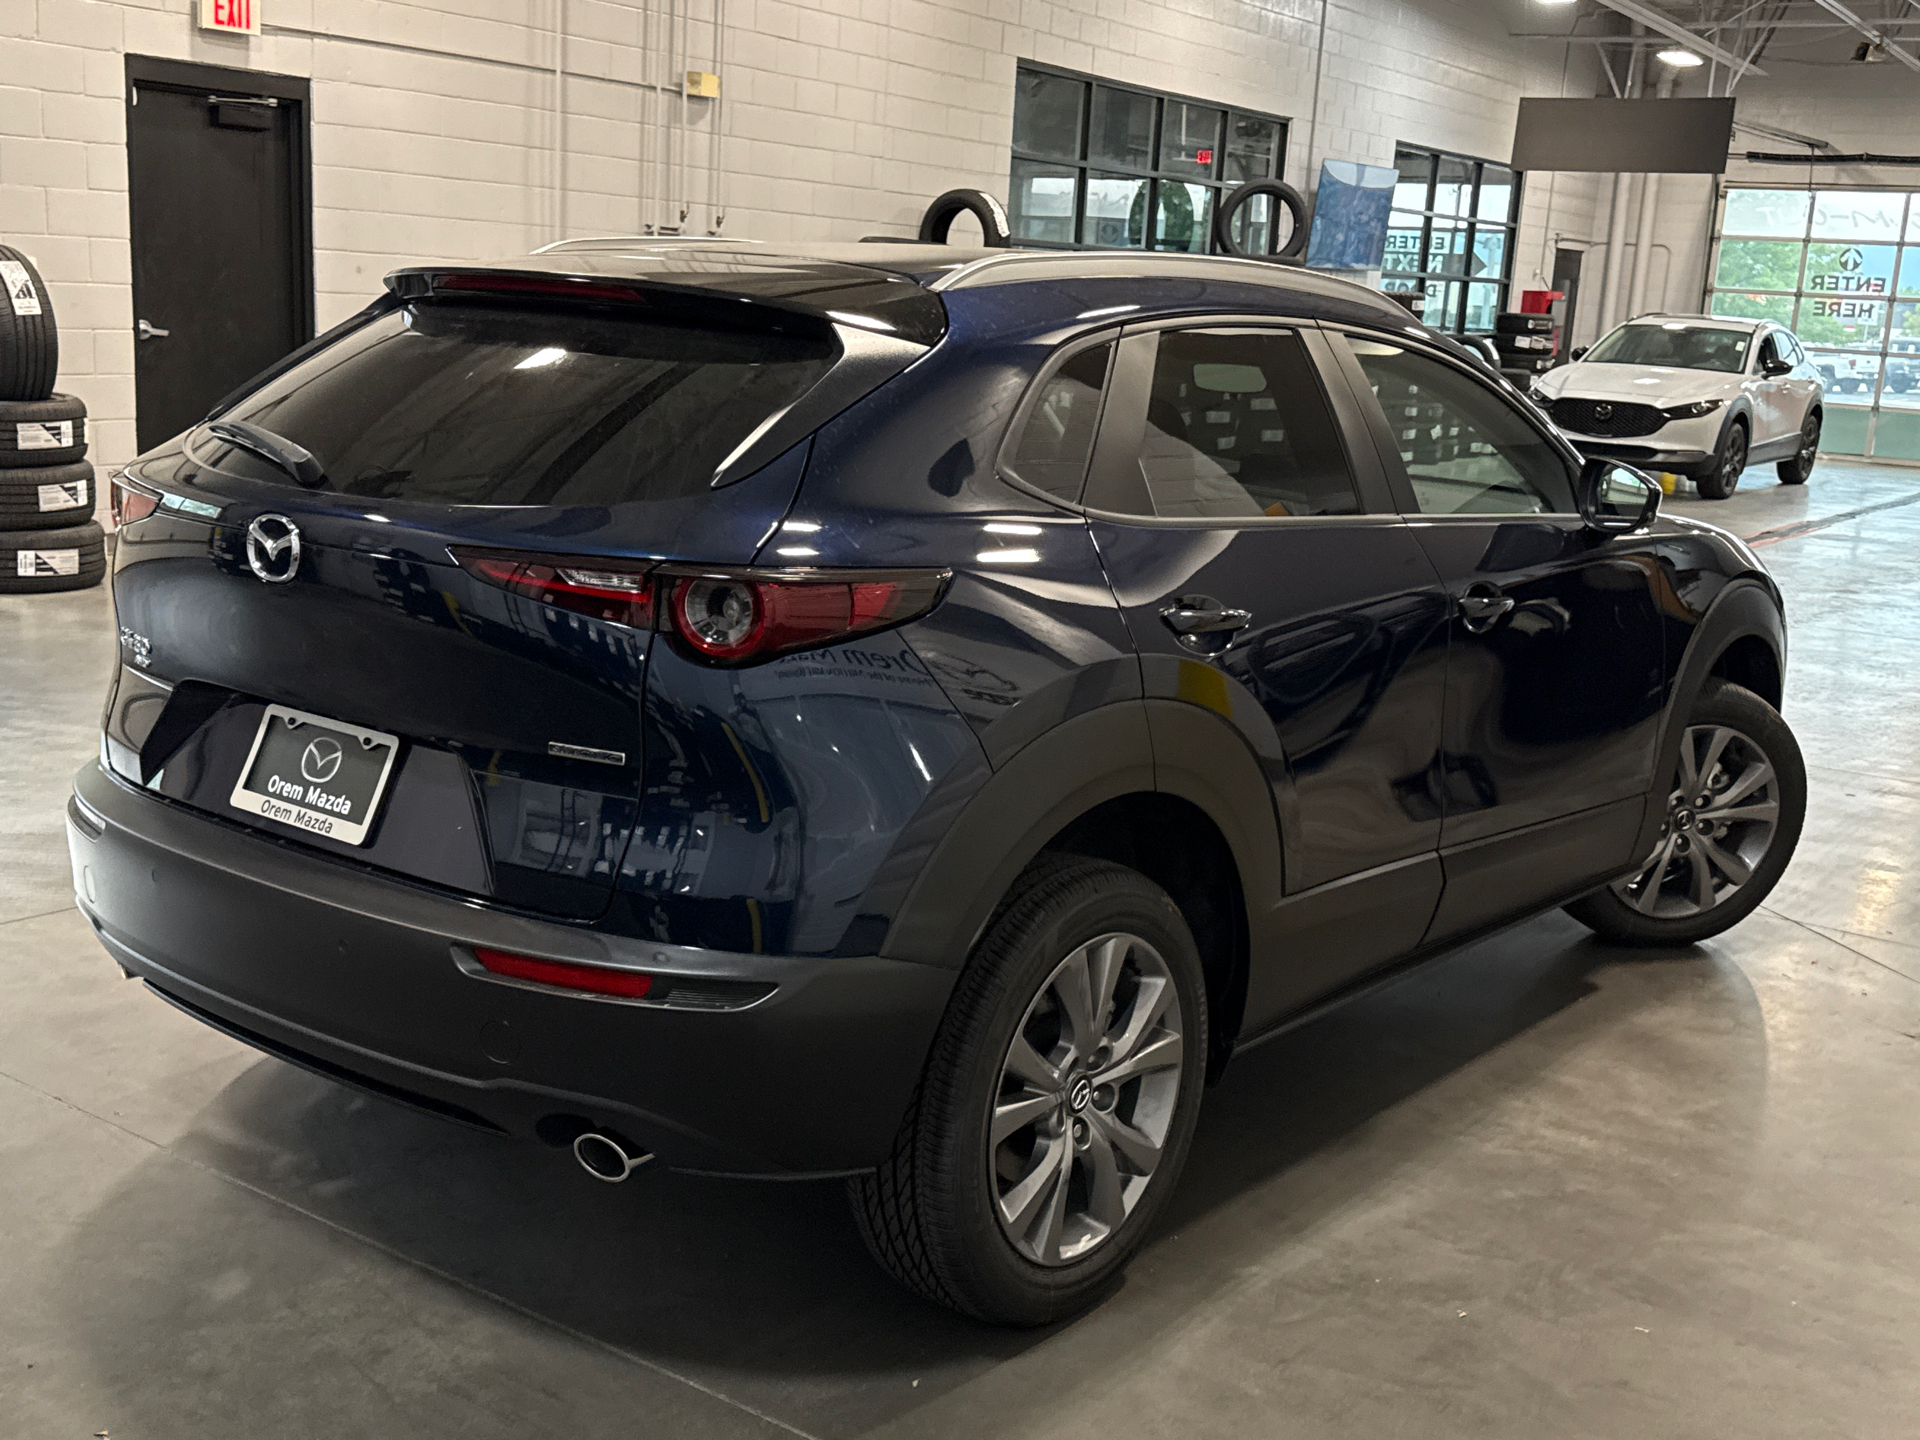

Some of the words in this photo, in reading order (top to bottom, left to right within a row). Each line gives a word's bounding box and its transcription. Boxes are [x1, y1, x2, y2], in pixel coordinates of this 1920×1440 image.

[267, 774, 304, 800] Orem
[305, 786, 351, 815] Mazda
[261, 800, 292, 821] Orem
[294, 809, 333, 834] Mazda
